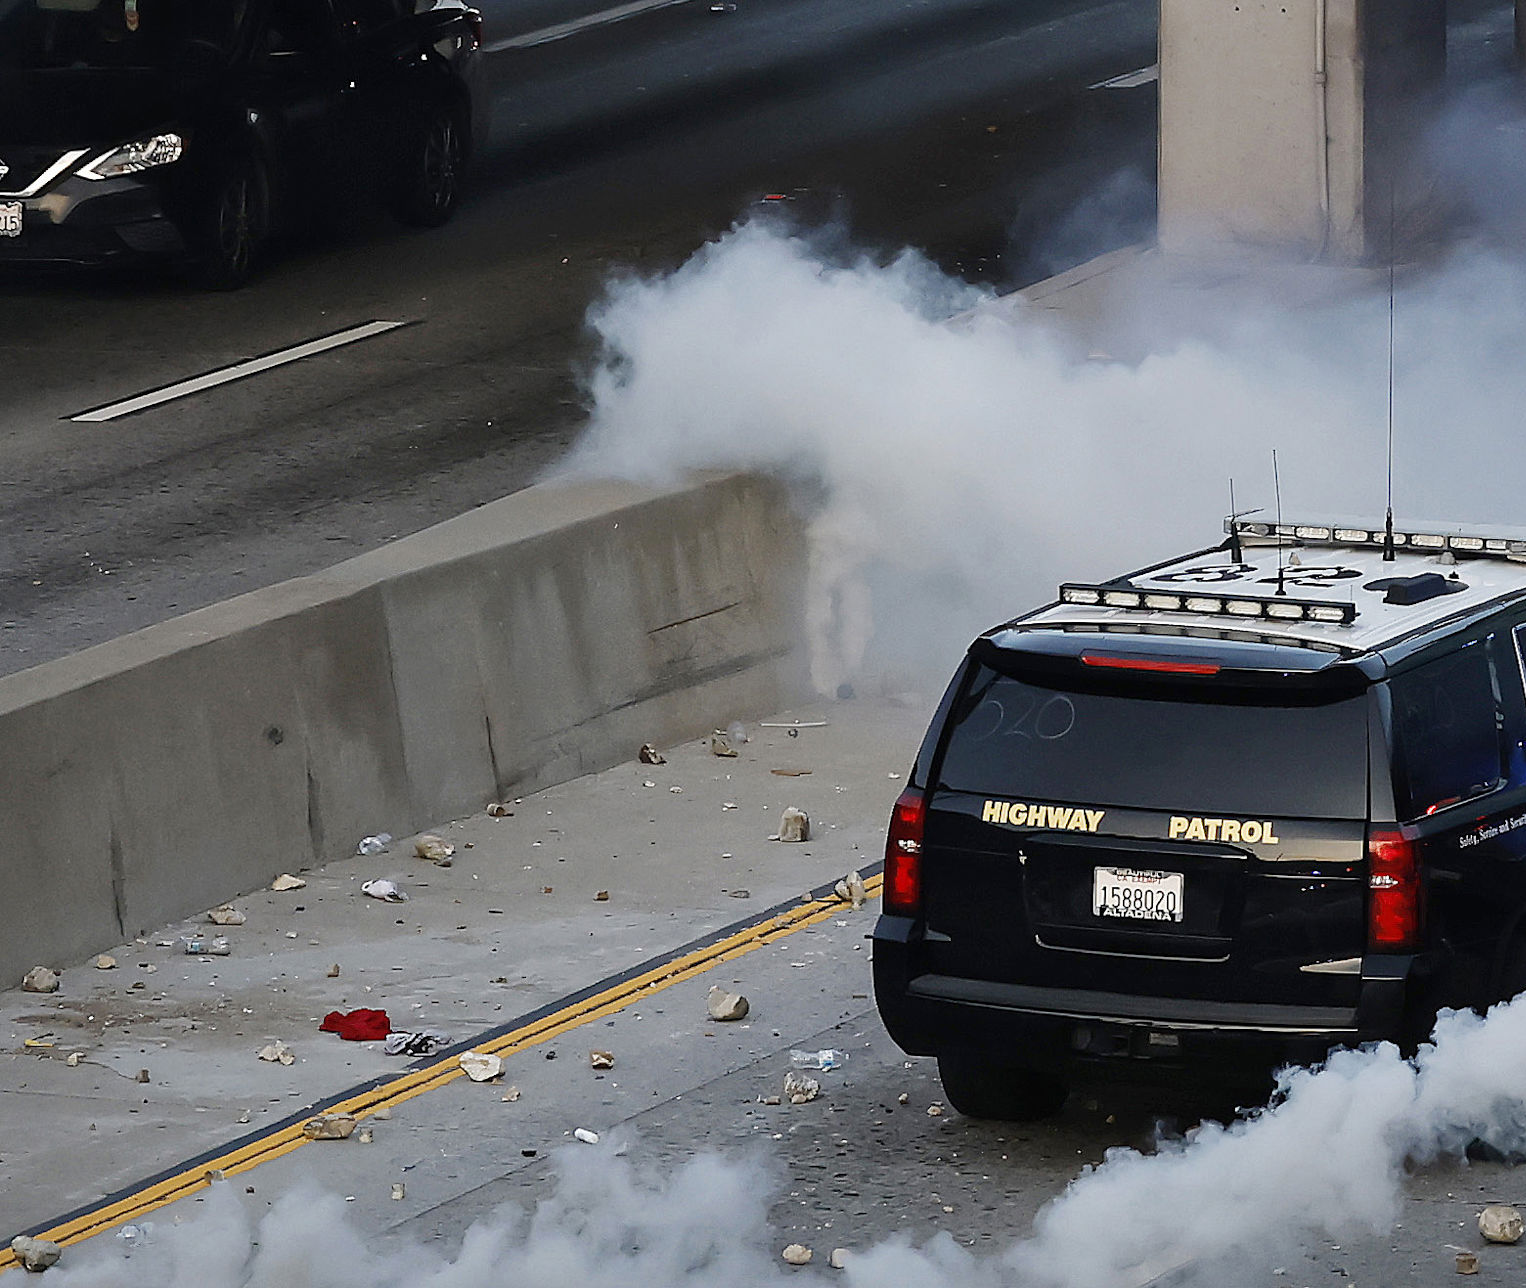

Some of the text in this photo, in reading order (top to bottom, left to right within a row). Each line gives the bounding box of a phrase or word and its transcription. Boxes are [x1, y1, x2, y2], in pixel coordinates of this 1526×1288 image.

[982, 800, 1279, 844] HIGHWAY PATROL
[1101, 886, 1176, 912] 1588020
[1103, 908, 1172, 922] ALTADENA
